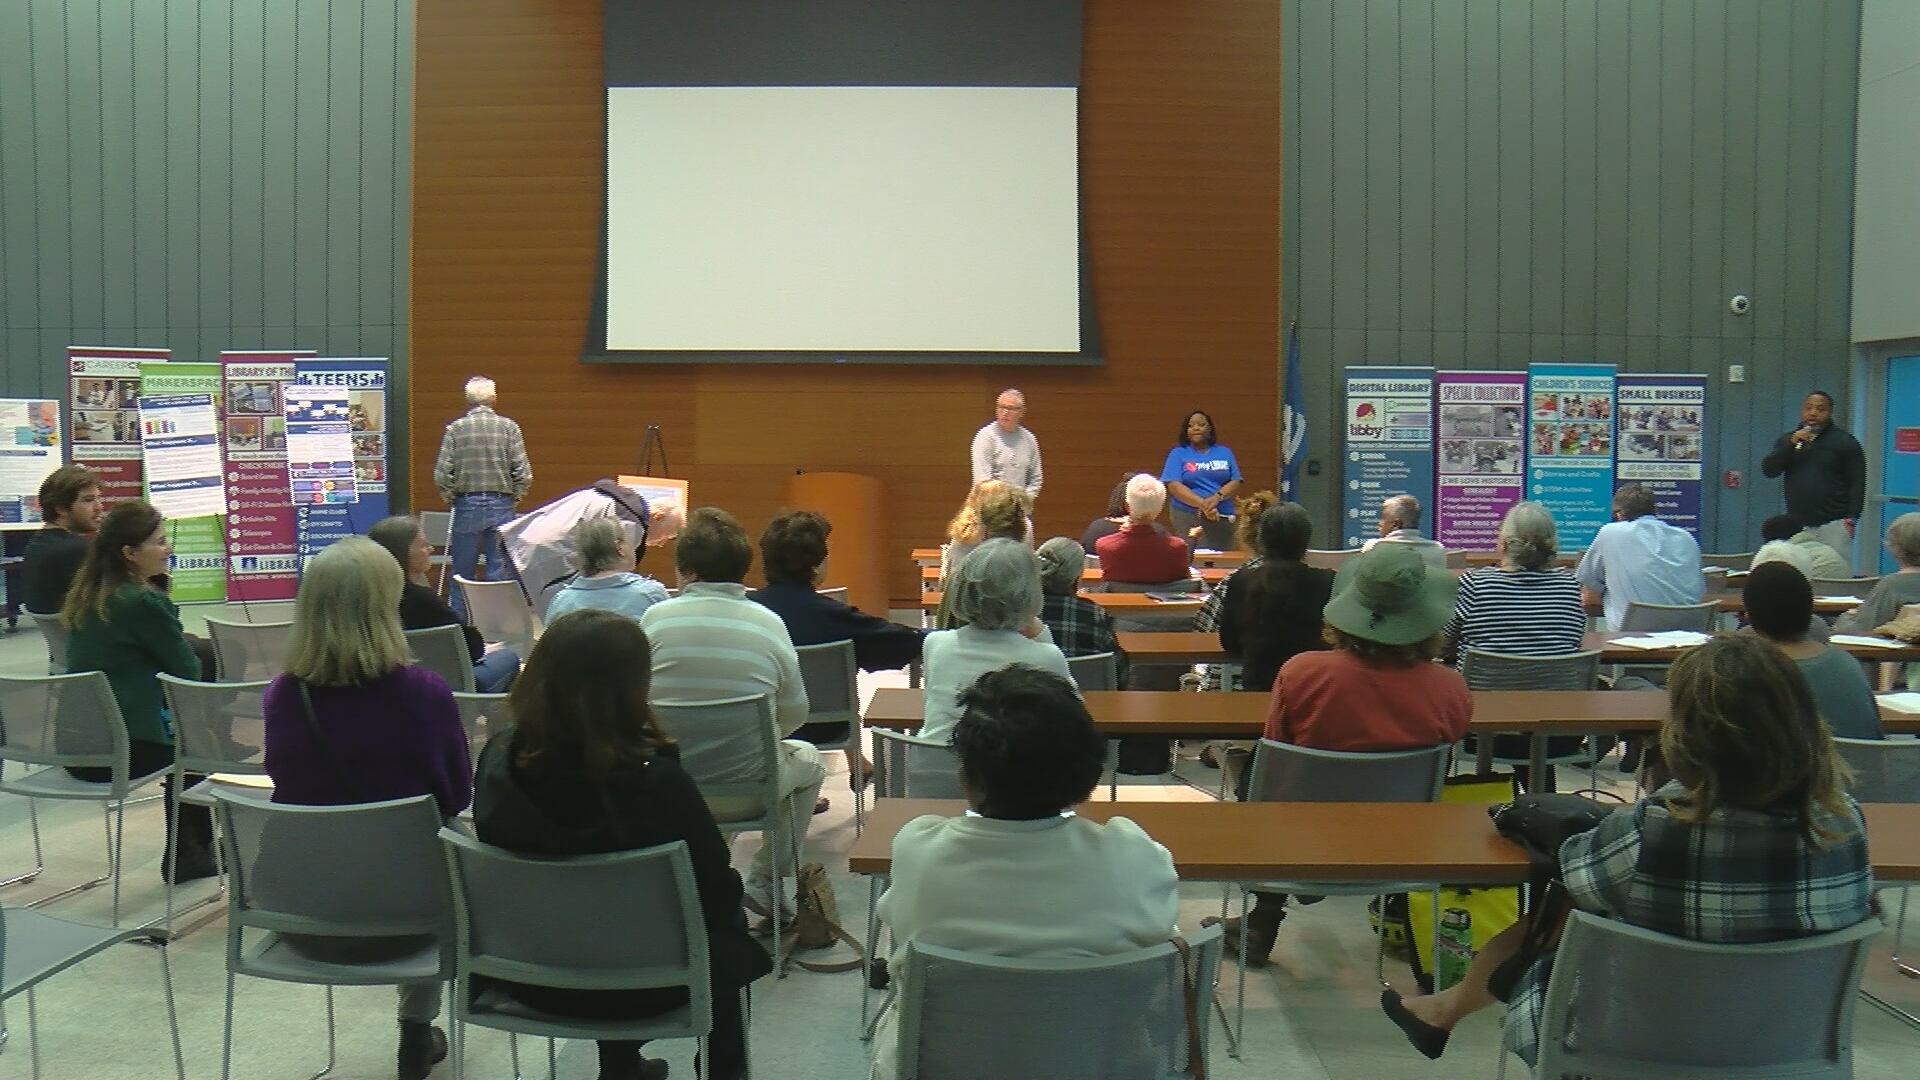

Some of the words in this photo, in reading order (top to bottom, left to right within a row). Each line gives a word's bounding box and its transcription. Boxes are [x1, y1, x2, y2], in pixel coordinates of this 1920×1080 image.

[227, 367, 265, 377] LIBRARY
[266, 367, 278, 376] OF
[312, 373, 369, 386] TEENS
[1349, 383, 1387, 393] DIGITAL
[1388, 383, 1430, 393] LIBRARY
[1443, 385, 1472, 400] SPECIAL
[1474, 385, 1520, 400] COLLECTIONS
[1620, 390, 1653, 400] SMALL
[1655, 390, 1703, 400] BUSINESS
[1349, 423, 1384, 439] libby
[239, 462, 262, 470] CHECK
[263, 461, 285, 469] THESE
[179, 557, 227, 570] LIBRARY
